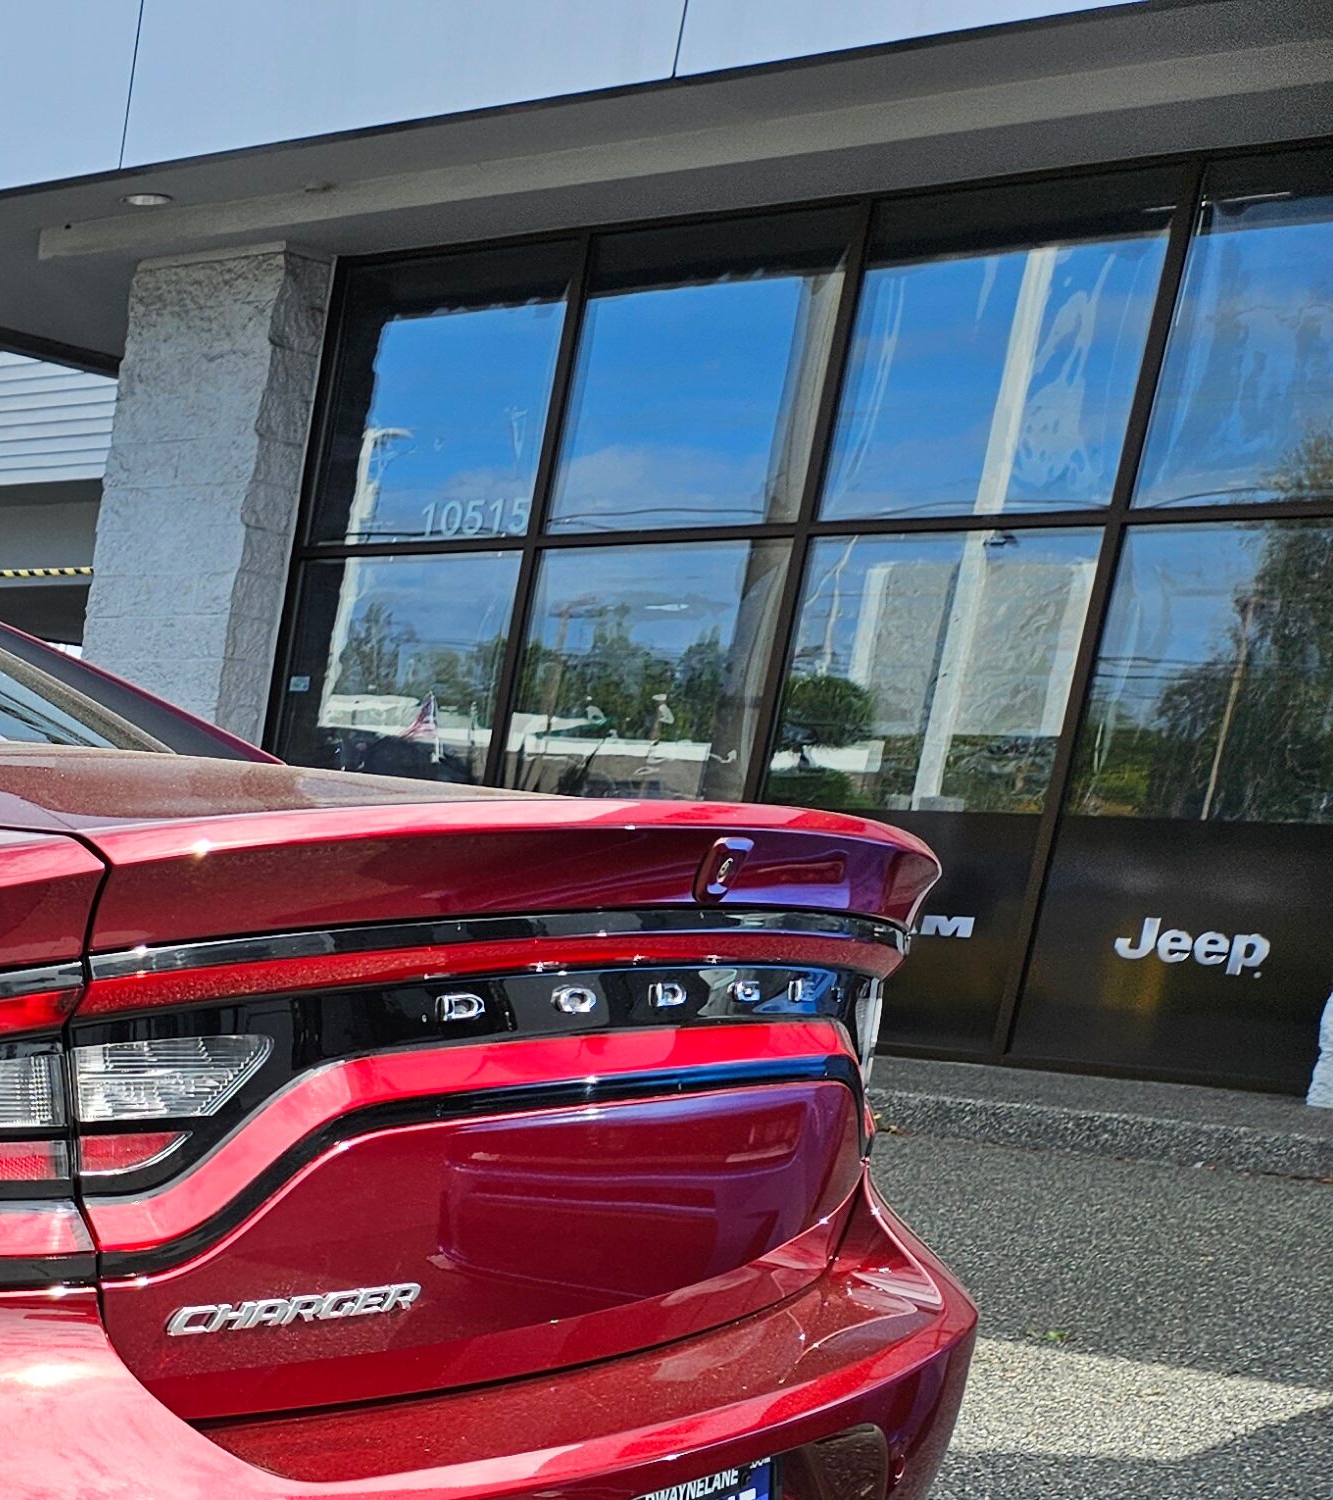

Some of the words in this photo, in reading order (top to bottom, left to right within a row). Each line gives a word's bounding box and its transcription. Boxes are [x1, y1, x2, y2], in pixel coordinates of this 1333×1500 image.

[422, 498, 531, 537] 10515
[1115, 917, 1271, 975] Jeep
[435, 979, 821, 1022] DODGE
[165, 1282, 422, 1337] CHARGER
